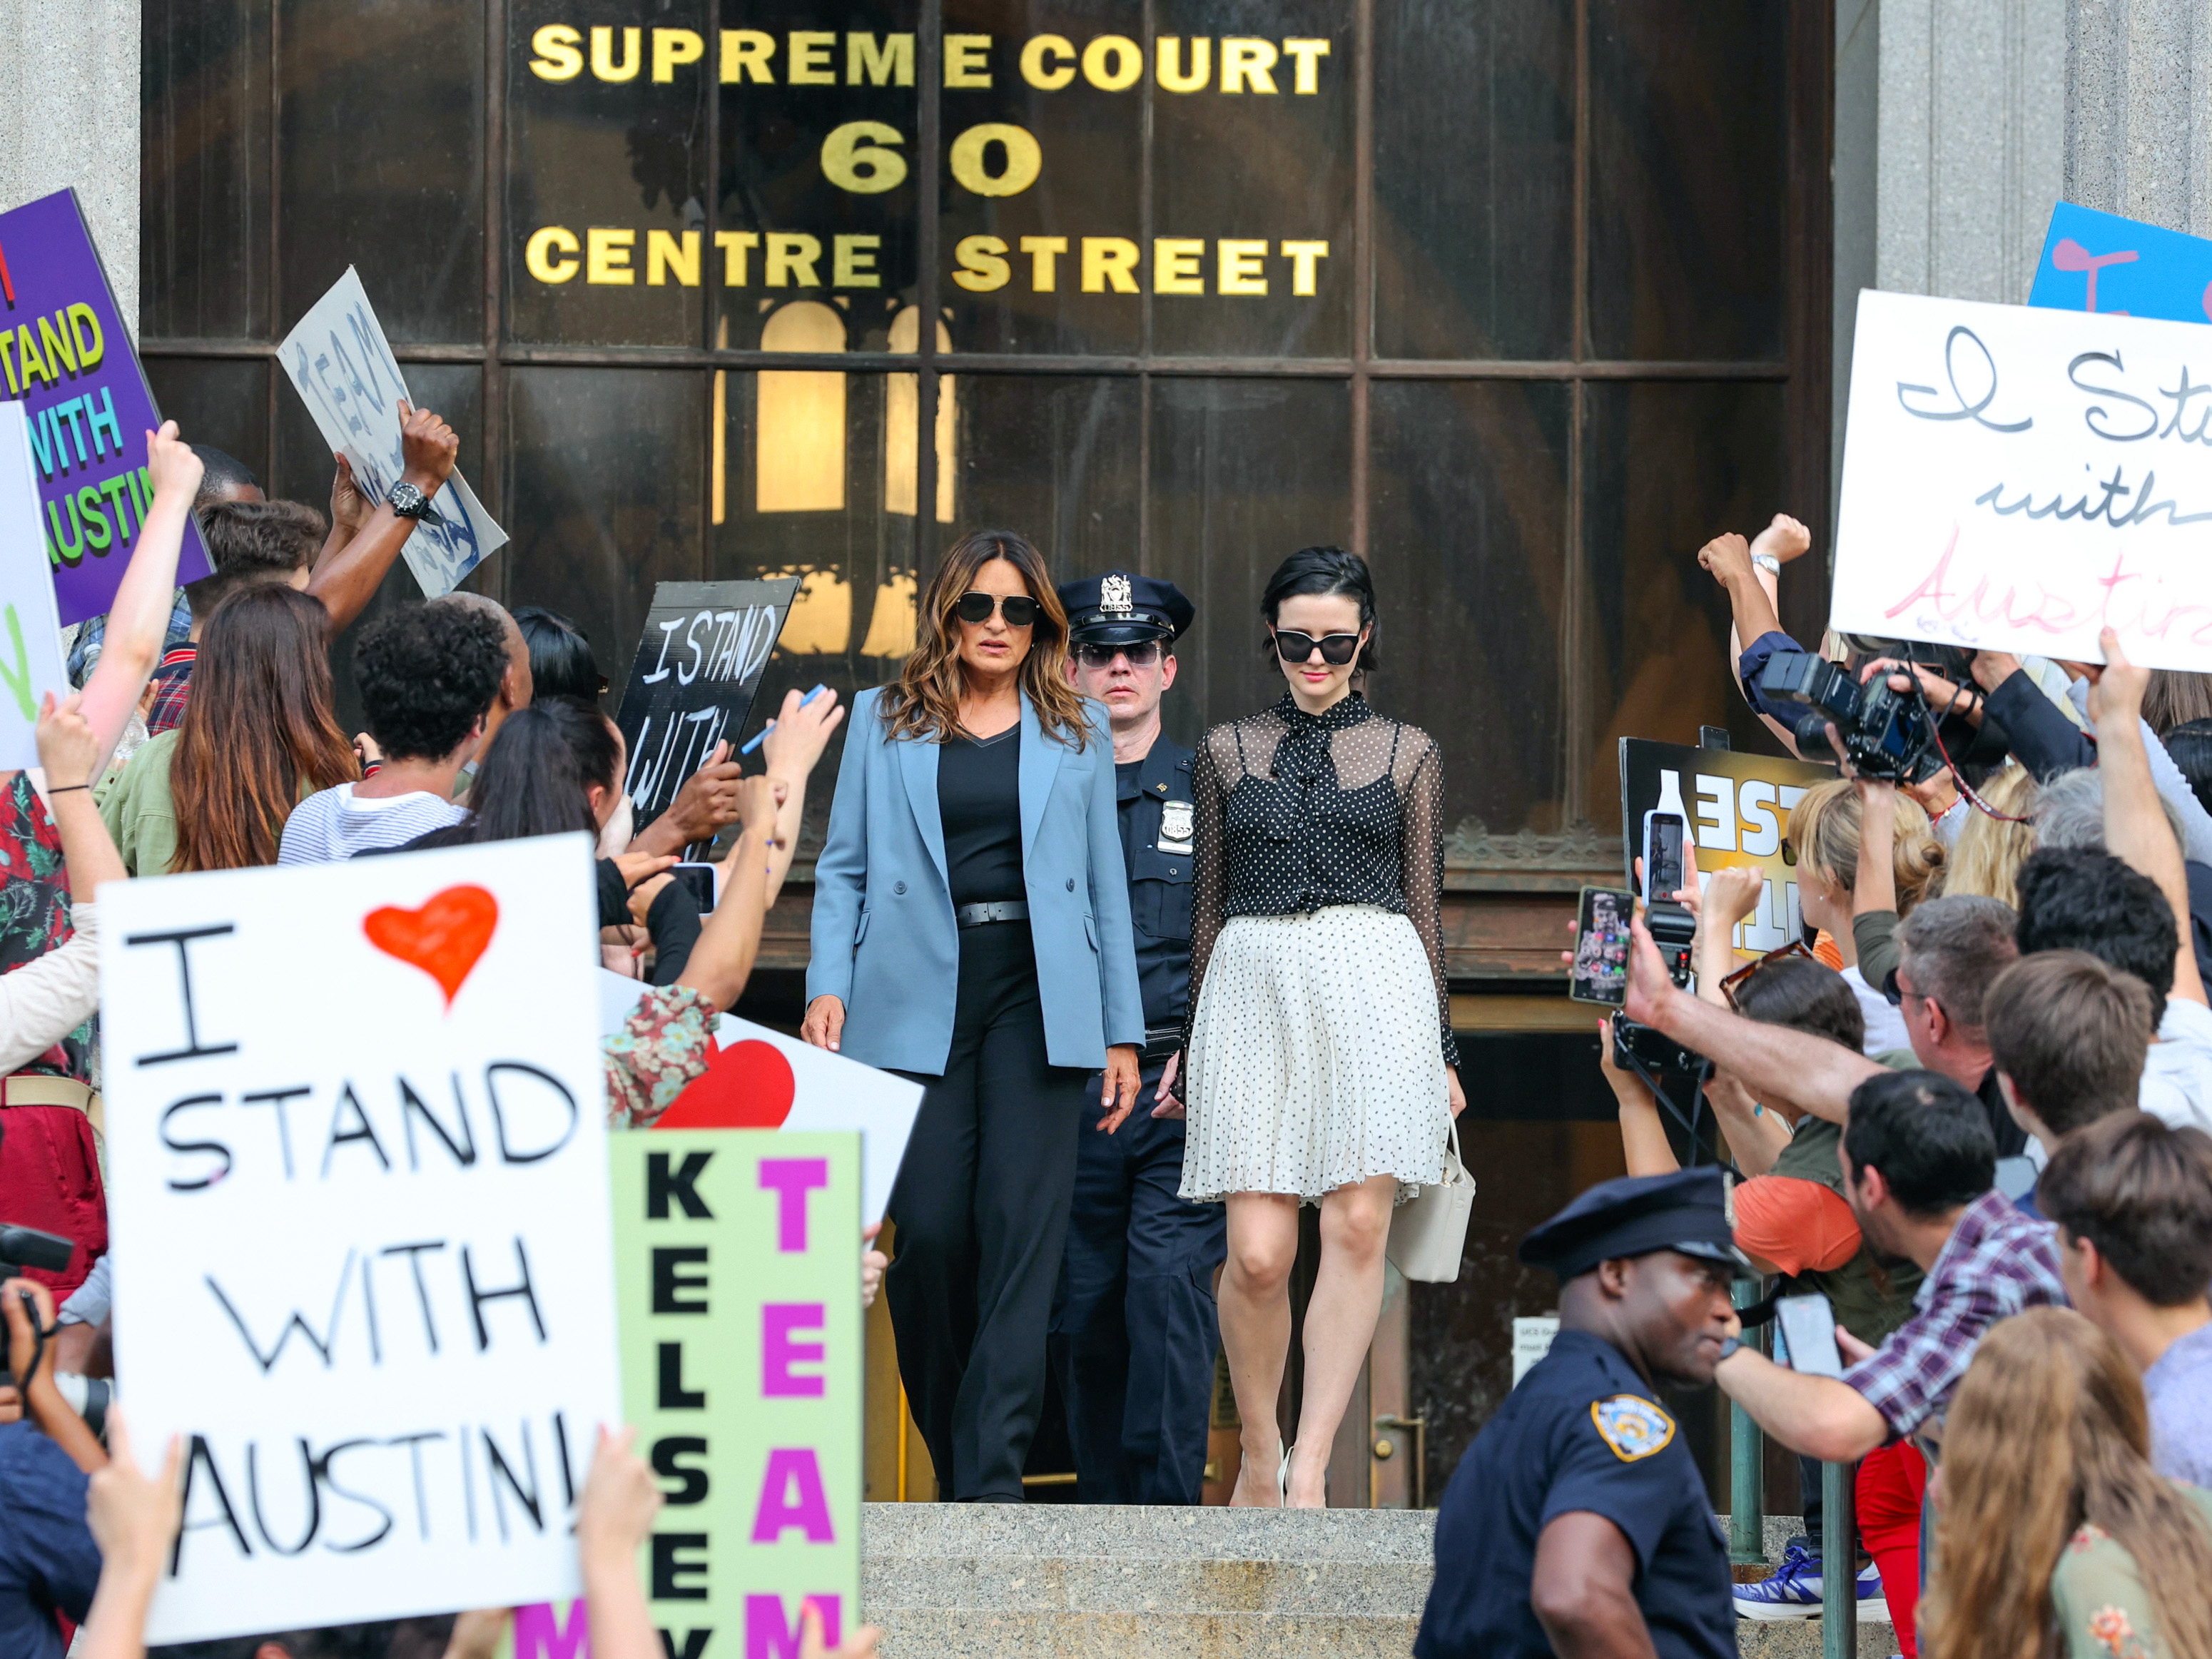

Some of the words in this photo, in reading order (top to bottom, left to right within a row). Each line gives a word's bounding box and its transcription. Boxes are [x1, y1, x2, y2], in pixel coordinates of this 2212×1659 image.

[528, 24, 993, 86] SUPREME
[1019, 34, 1331, 94] COURT
[821, 121, 1042, 196] 60
[525, 226, 882, 287] CENTRE
[953, 236, 1329, 295] STREET
[0, 302, 104, 395] TAND
[295, 300, 410, 450] TEAM
[1897, 325, 2033, 433] I
[2068, 349, 2212, 447] St
[1975, 462, 2212, 528] with
[642, 617, 686, 684] I
[678, 603, 776, 686] STAND
[126, 924, 239, 1066] I
[159, 1060, 579, 1191] STAND
[204, 1235, 548, 1375] WITH
